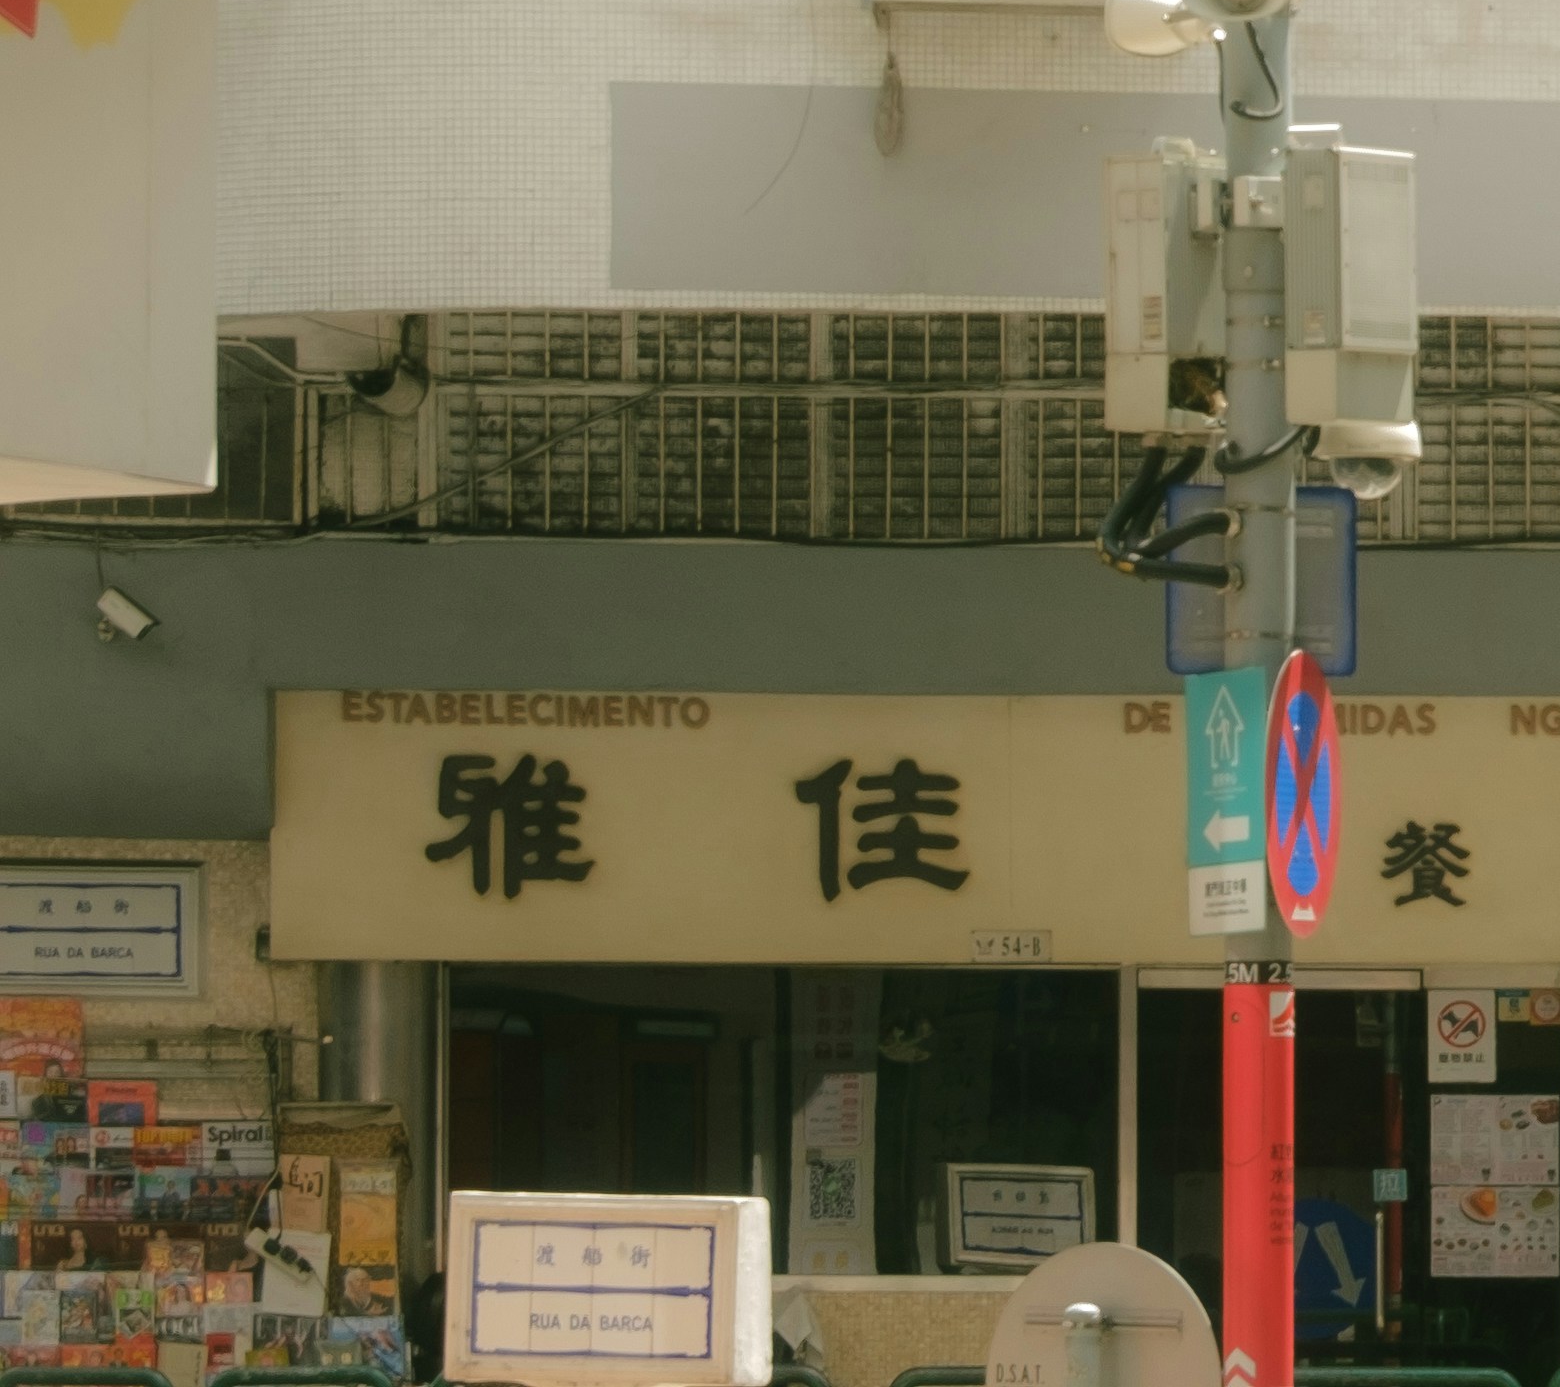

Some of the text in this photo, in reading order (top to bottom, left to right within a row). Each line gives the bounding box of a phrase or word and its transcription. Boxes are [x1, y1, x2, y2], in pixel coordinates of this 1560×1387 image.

[340, 689, 712, 729] ESTABELECIMENTO
[1122, 701, 1172, 735] DE
[424, 753, 970, 903] 雅佳
[34, 946, 134, 959] RUA DA BARCA
[1001, 935, 1041, 957] 54-B
[208, 1126, 264, 1145] Spiral
[529, 1313, 654, 1332] RUA DA BARCA
